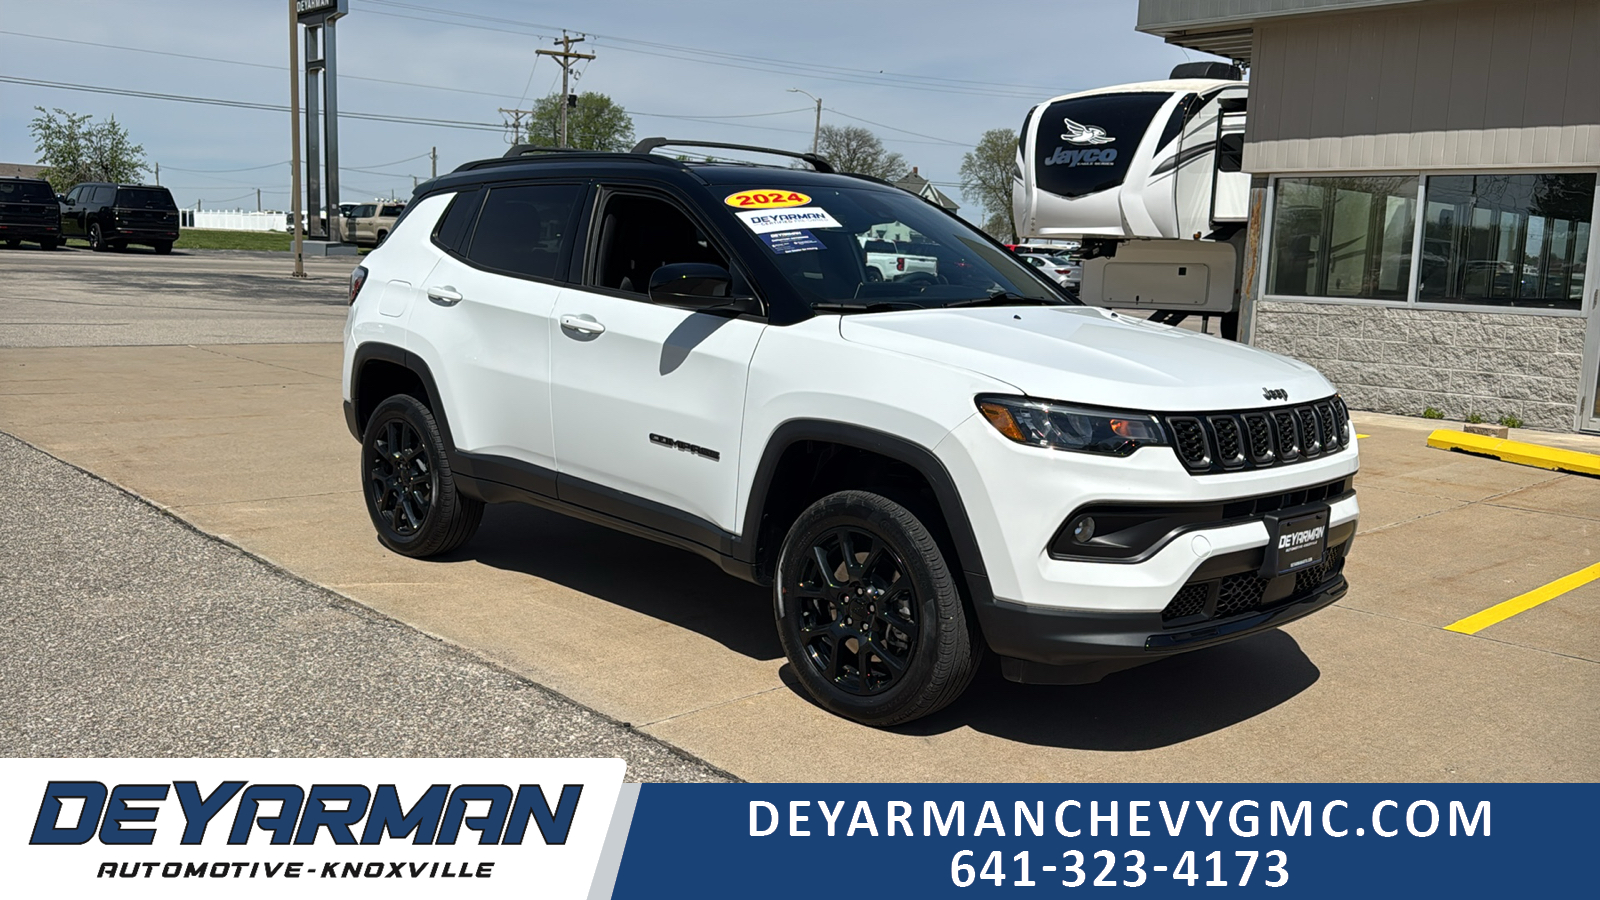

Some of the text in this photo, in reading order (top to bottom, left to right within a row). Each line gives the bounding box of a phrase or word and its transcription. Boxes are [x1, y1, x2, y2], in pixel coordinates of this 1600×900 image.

[1044, 146, 1118, 167] Jayco
[736, 193, 804, 206] 2024
[750, 213, 826, 224] DEYARMAN
[1262, 387, 1289, 402] Jeep
[1278, 525, 1325, 549] DEYARMAN
